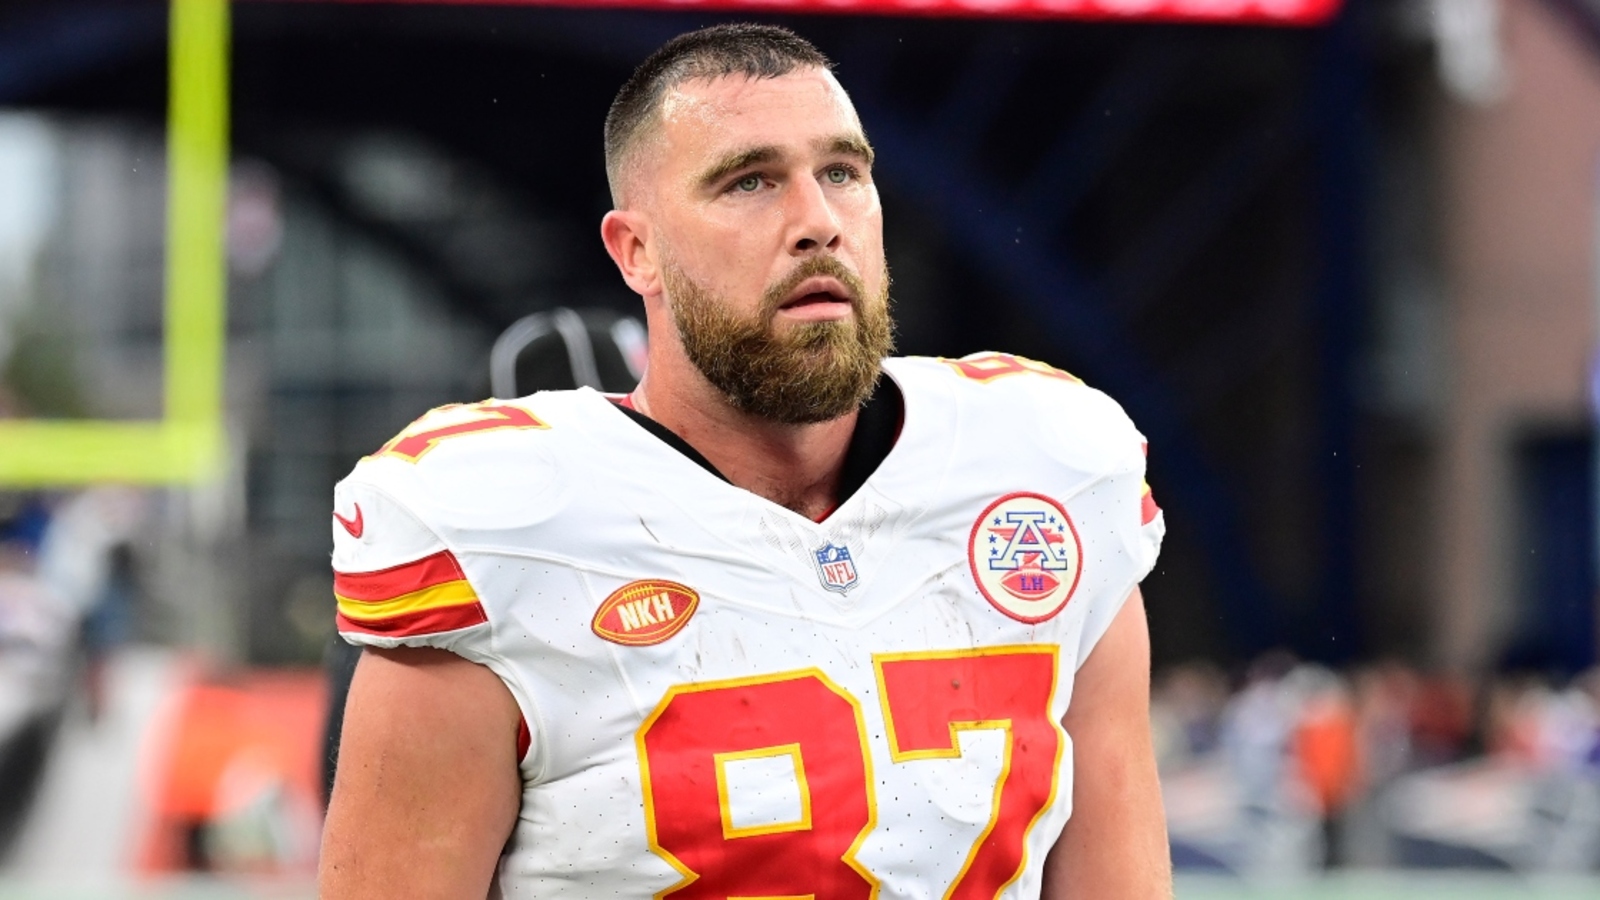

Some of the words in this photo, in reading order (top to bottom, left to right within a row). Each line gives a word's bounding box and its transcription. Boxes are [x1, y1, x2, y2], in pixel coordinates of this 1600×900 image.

[361, 397, 551, 464] 7
[988, 511, 1067, 570] A
[823, 562, 854, 584] NFL
[1020, 576, 1044, 591] LH
[616, 592, 675, 632] NKH
[635, 644, 1064, 900] 87
